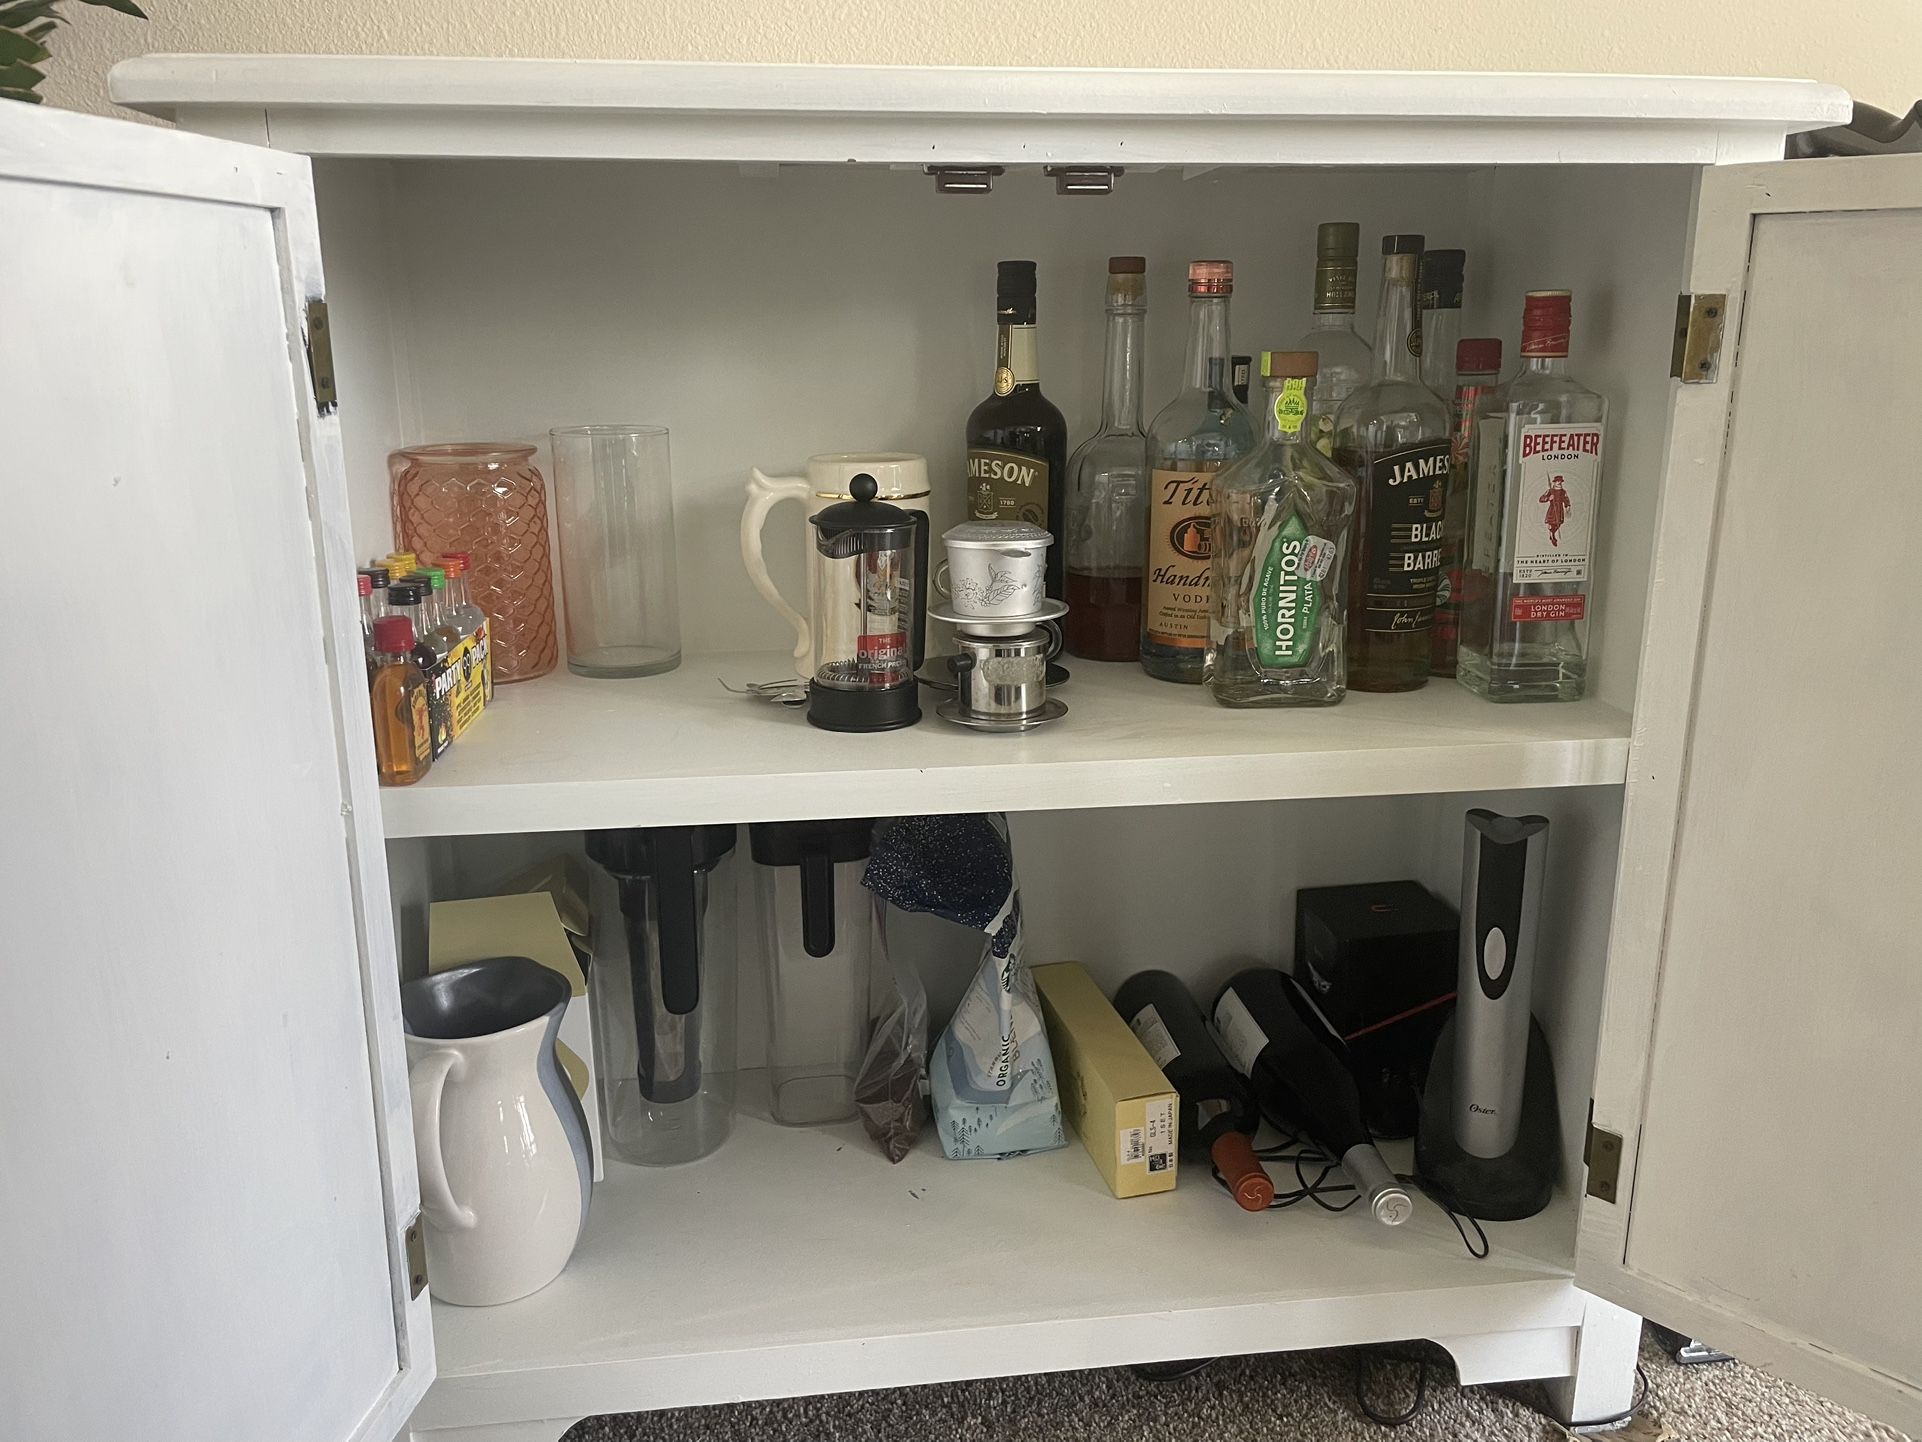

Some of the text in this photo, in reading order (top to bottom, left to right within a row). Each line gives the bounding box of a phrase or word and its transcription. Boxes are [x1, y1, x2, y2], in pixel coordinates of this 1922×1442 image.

[1522, 432, 1600, 458] BEEFEATER
[1542, 453, 1579, 461] LONDON
[1263, 566, 1274, 587] AGAVE
[1261, 587, 1267, 596] DE
[1275, 540, 1301, 656] HORNITOS
[1302, 582, 1313, 614] PLATA
[1159, 622, 1188, 630] AUSTIN
[436, 659, 461, 699] PARTY
[996, 1035, 1011, 1087] ORGANIC
[1469, 1103, 1496, 1115] Oster
